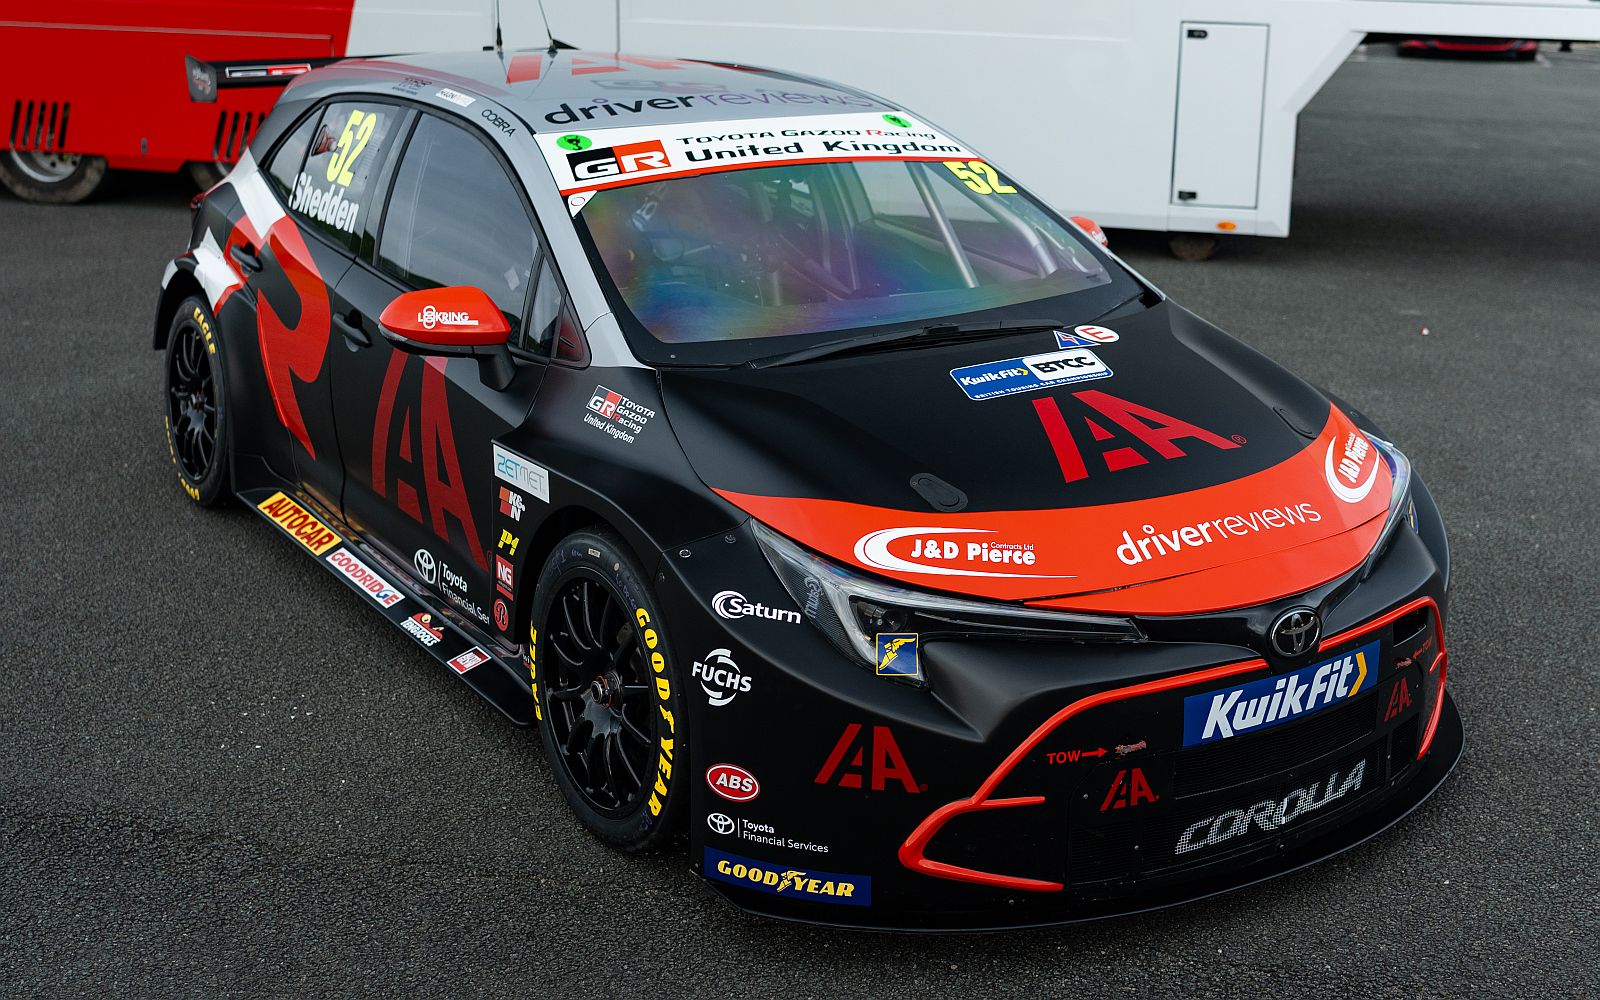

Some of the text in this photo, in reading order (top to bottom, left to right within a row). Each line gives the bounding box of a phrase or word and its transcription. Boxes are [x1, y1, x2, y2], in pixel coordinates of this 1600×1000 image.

[481, 109, 516, 137] COBRA
[326, 109, 377, 188] 52
[676, 129, 936, 145] TOYOTA GAZOO Racing
[684, 140, 961, 162] United Kingdom
[574, 150, 669, 180] GR
[943, 160, 1018, 195] 52
[289, 171, 359, 234] Shedden
[193, 306, 216, 355] EAGLE
[1079, 327, 1115, 340] E
[1031, 356, 1096, 373] BTCC
[588, 395, 616, 418] GR
[616, 405, 648, 425] GAZOO
[621, 396, 656, 418] TOYOTA
[583, 412, 635, 444] United Kingdom
[611, 413, 643, 434] Racing
[262, 497, 335, 552] AUTOCAR
[911, 538, 1036, 566] J&D Pierce
[990, 541, 1035, 551] Contracts Ltd
[331, 551, 400, 606] GOODRIDGE
[442, 562, 468, 593] Toyota
[497, 560, 512, 587] NG
[441, 581, 477, 617] Financial
[728, 598, 801, 624] Saturn
[691, 661, 752, 693] FUCHS
[1046, 749, 1081, 765] TOW
[715, 772, 754, 793] ABS
[1174, 758, 1367, 855] COROLLA
[742, 818, 775, 835] Toyota
[743, 830, 829, 854] Financial Services
[717, 859, 855, 897] GOODYEAR
